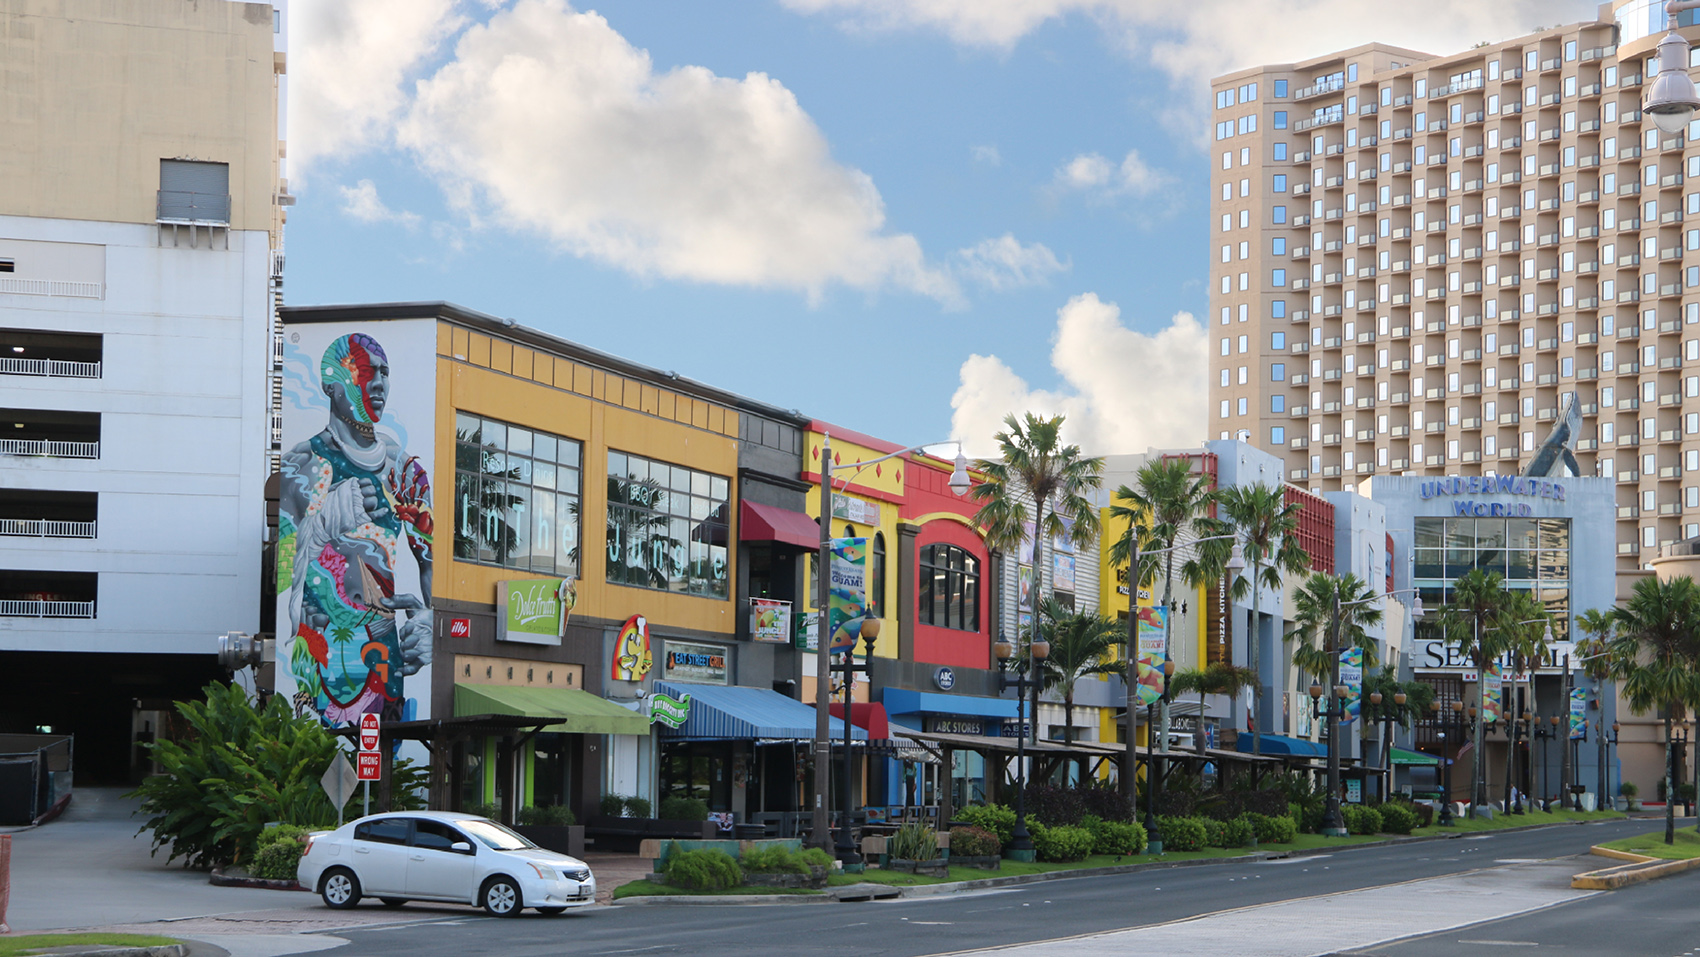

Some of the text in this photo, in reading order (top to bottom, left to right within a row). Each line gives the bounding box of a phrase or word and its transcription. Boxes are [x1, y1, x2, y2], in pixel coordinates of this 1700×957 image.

[524, 461, 555, 487] Dning
[1420, 474, 1566, 501] UNDERWATER
[1452, 500, 1532, 517] WORLD
[461, 493, 575, 555] In The
[609, 522, 724, 580] Jungle
[832, 575, 863, 588] GUAM!
[451, 621, 468, 636] illy
[755, 626, 786, 634] JUNGLE
[675, 652, 726, 668] EAT STREET GRILL
[1424, 641, 1477, 668] SEA
[940, 671, 952, 681] ABC
[1465, 673, 1527, 681] RERANT
[363, 720, 369, 728] DO
[936, 720, 981, 734] ABC STORES
[363, 736, 376, 744] ENTER
[360, 756, 379, 766] WRONG
[363, 766, 375, 776] WAY
